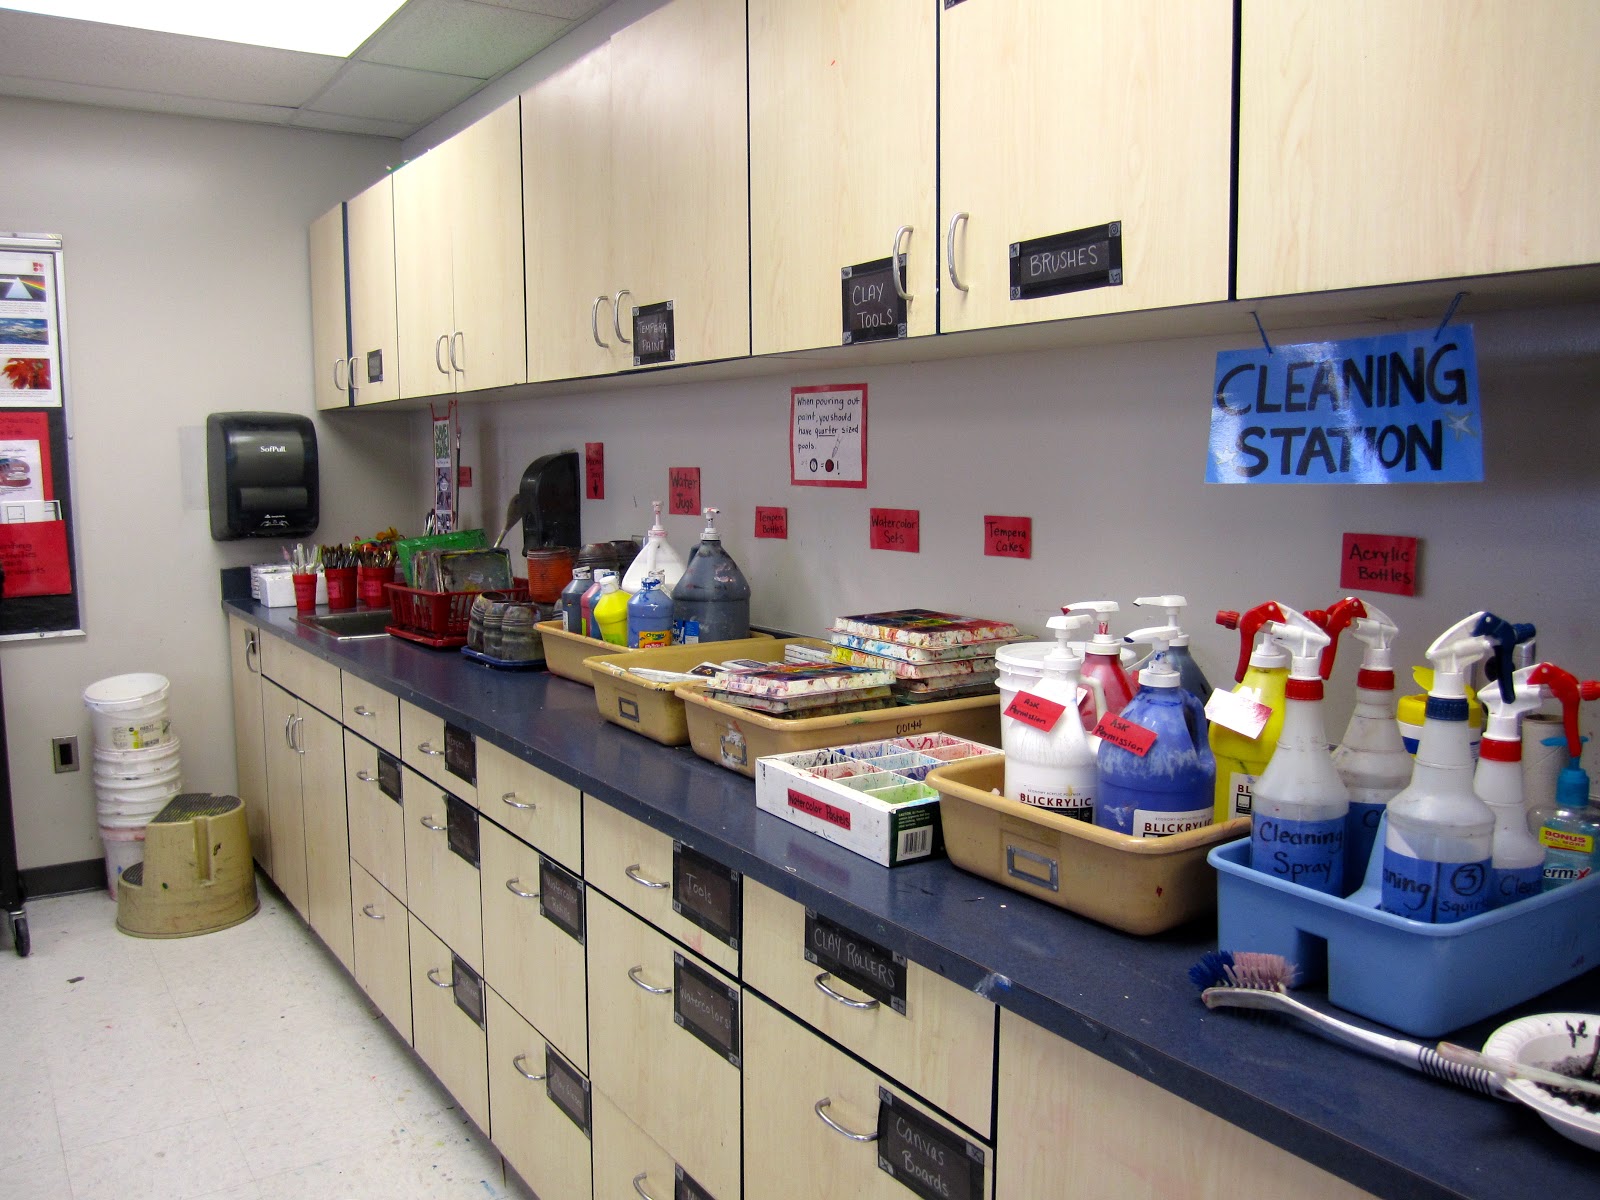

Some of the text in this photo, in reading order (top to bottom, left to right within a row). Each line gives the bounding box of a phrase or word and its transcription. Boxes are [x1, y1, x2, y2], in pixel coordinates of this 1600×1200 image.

[1030, 245, 1098, 277] BRUSHES
[852, 283, 884, 306] CLAY
[857, 308, 893, 329] TOOLS
[642, 339, 664, 351] PAINT
[1216, 343, 1467, 416] CLEANING
[797, 397, 860, 410] When pouring out
[819, 415, 829, 425] you
[830, 412, 852, 422] should
[798, 424, 859, 438] have quarter sized
[670, 471, 697, 489] Water
[676, 493, 693, 514] Jugs
[884, 530, 904, 544] Sets
[985, 521, 1026, 541] Tempera
[1349, 543, 1409, 566] Acrylic
[1358, 566, 1411, 585] Bottles
[1009, 704, 1046, 724] Permission
[1095, 725, 1144, 752] Permission
[1020, 793, 1093, 807] BLICKRYLIC
[1260, 821, 1343, 854] Cleaning
[1545, 830, 1586, 842] BONUS
[1273, 851, 1332, 883] Spray
[1543, 868, 1591, 880] erm-X
[686, 872, 712, 905] Tools
[814, 928, 841, 959] CLAY
[847, 942, 895, 988] ROLLERS
[896, 1116, 944, 1166] Canvas
[902, 1150, 949, 1197] Boards
